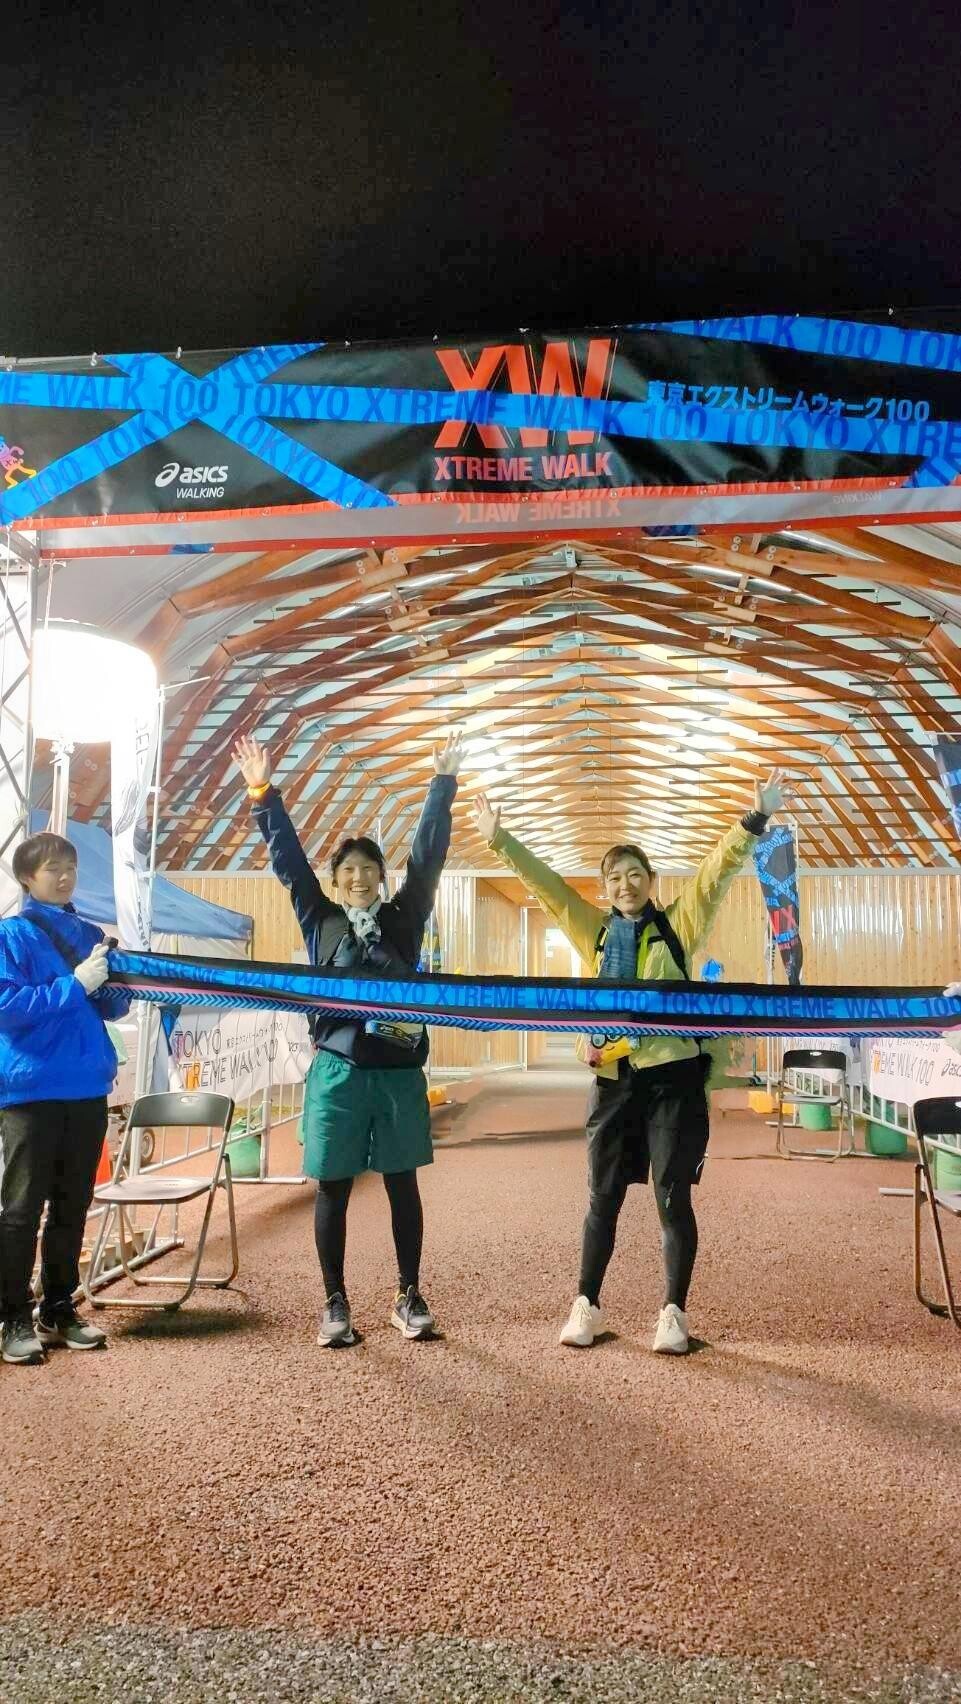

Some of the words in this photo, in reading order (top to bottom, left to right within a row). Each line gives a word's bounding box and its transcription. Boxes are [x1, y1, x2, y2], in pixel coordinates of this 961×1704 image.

[693, 315, 795, 349] WALK
[815, 319, 882, 360] 100
[434, 337, 618, 449] XW
[48, 374, 143, 412] WALK
[159, 379, 220, 417] 100
[232, 381, 350, 420] TOKYO
[362, 387, 508, 425] XTREME
[523, 393, 627, 437] WALK
[642, 404, 707, 441] 100
[722, 408, 850, 449] TOKYO
[179, 465, 229, 484] asics
[434, 456, 534, 481] XTREME
[541, 451, 613, 480] WALK
[176, 486, 225, 499] WALKING
[234, 969, 296, 992] WALK
[304, 976, 344, 998] 100
[353, 978, 428, 1004] TOKYO
[436, 984, 528, 1009] XTREME
[535, 987, 601, 1011] WALK
[611, 989, 651, 1012] 100
[660, 990, 731, 1015] TOKYO
[744, 995, 837, 1018] XTREME
[847, 996, 909, 1019] WALK
[174, 1029, 221, 1059] TOKYO
[181, 1056, 228, 1090] TREME
